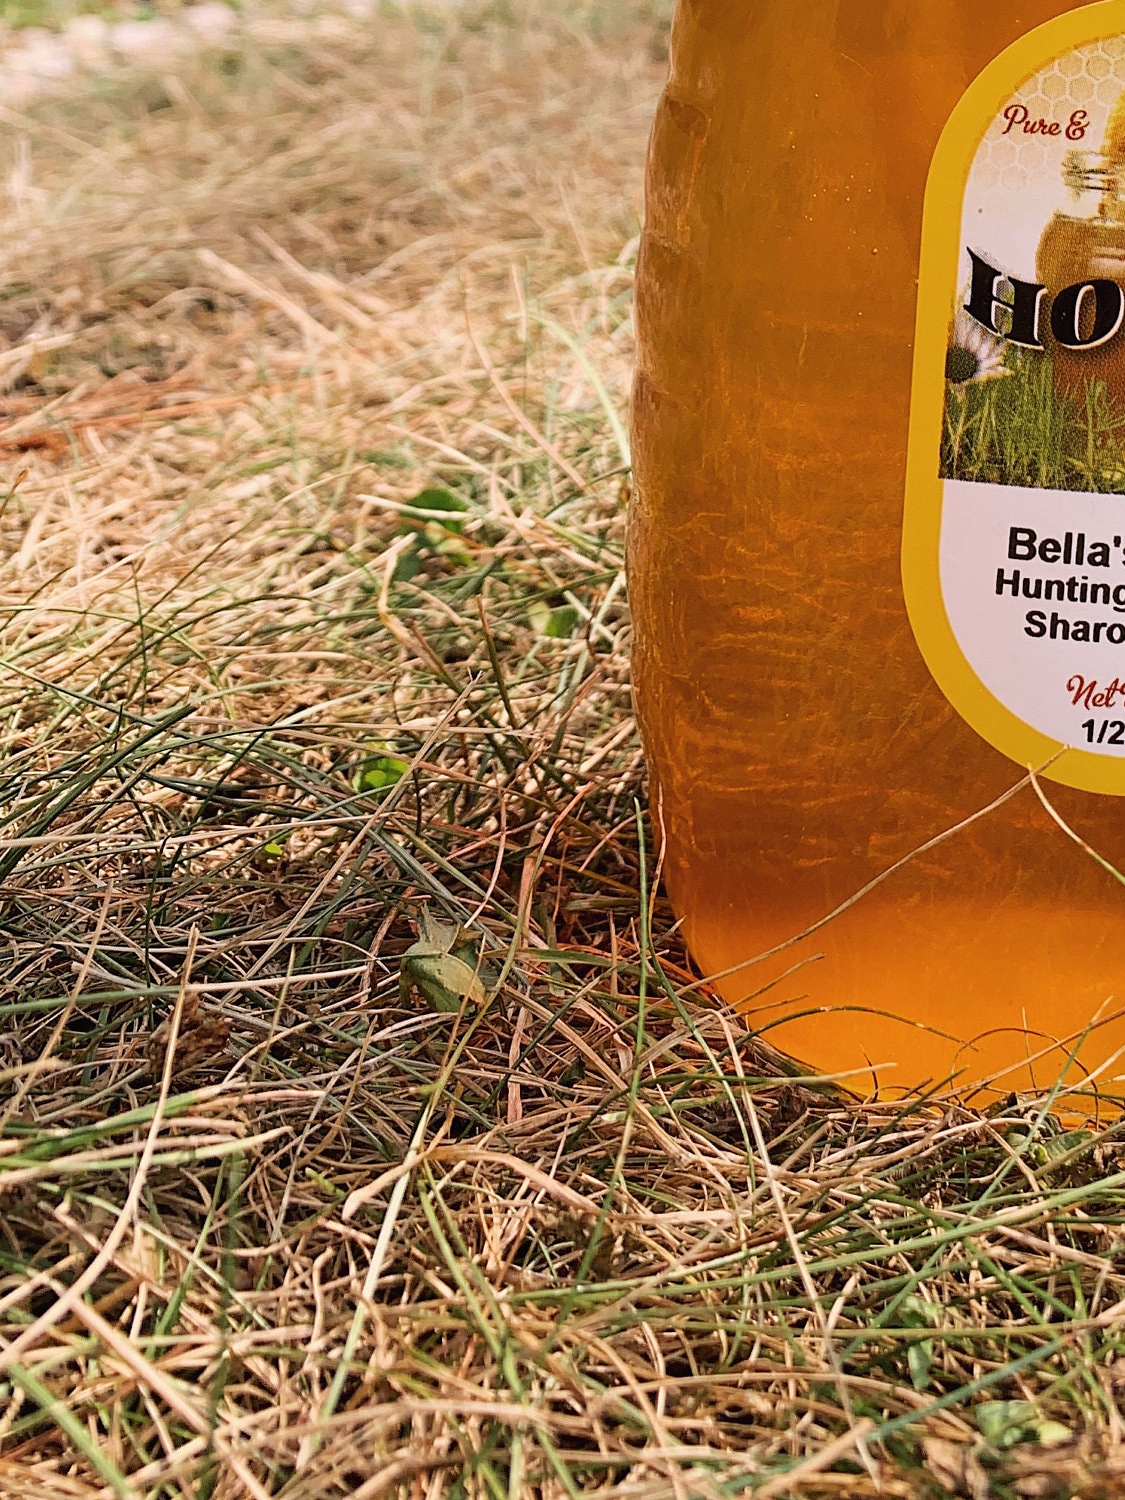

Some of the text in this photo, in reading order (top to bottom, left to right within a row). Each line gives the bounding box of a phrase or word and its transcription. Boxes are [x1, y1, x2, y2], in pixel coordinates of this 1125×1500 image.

[1002, 104, 1090, 141] Pure &
[1081, 719, 1125, 745] 1/2
